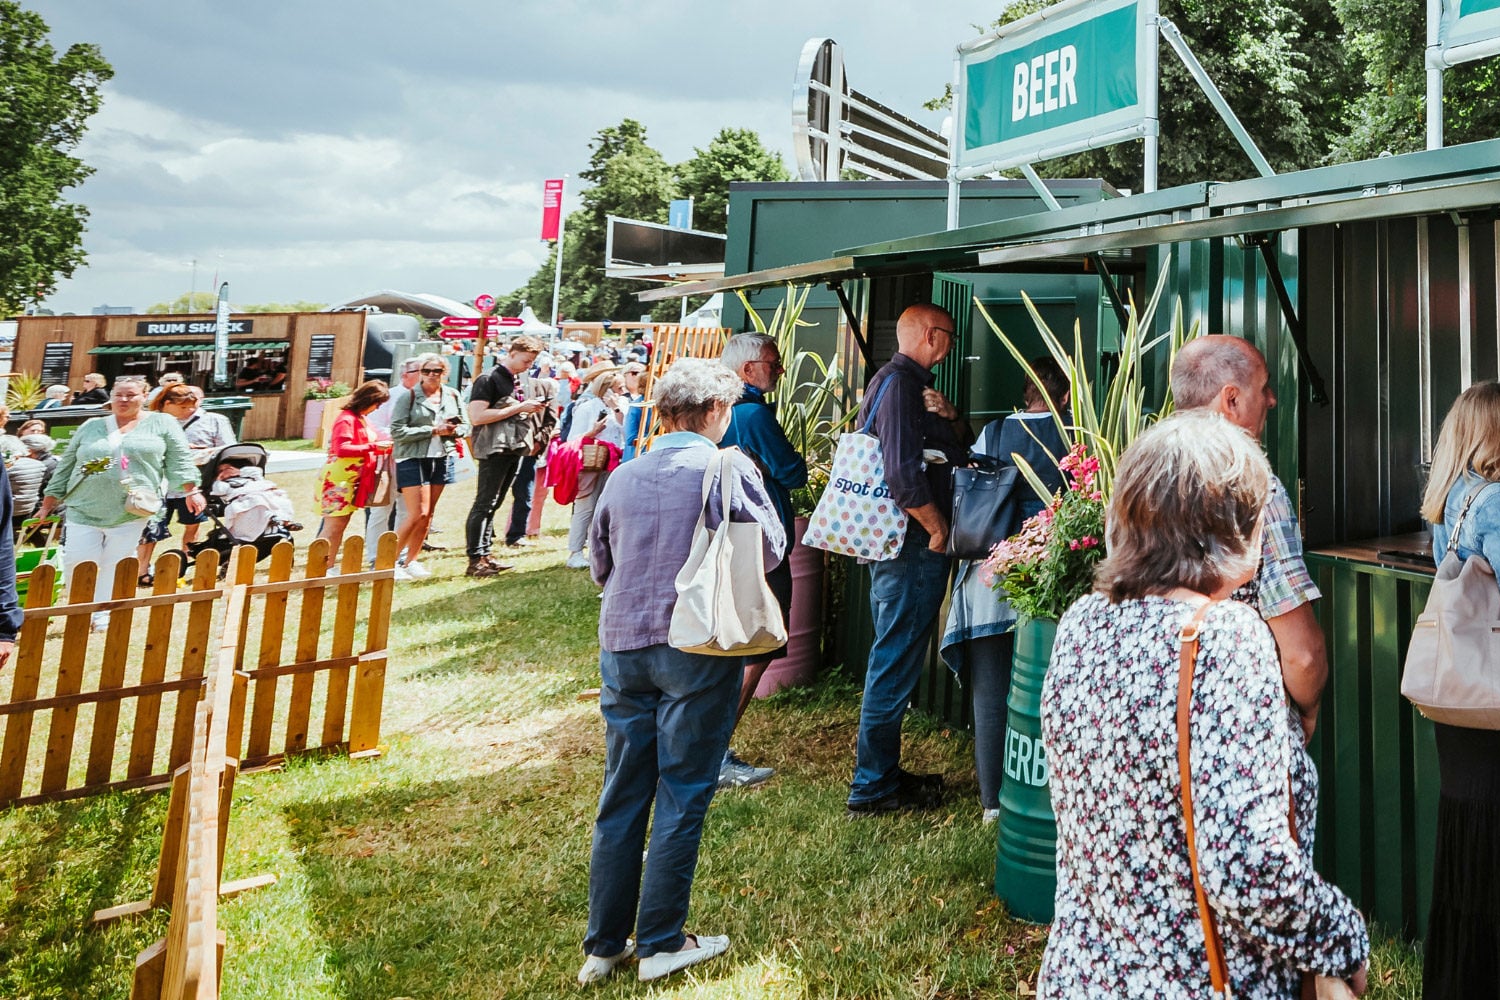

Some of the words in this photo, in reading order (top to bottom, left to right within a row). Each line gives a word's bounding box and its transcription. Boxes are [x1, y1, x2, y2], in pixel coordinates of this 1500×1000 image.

[1012, 44, 1078, 123] BEER
[147, 323, 186, 334] RUM
[187, 322, 244, 333] SHAK
[834, 477, 871, 496] spot
